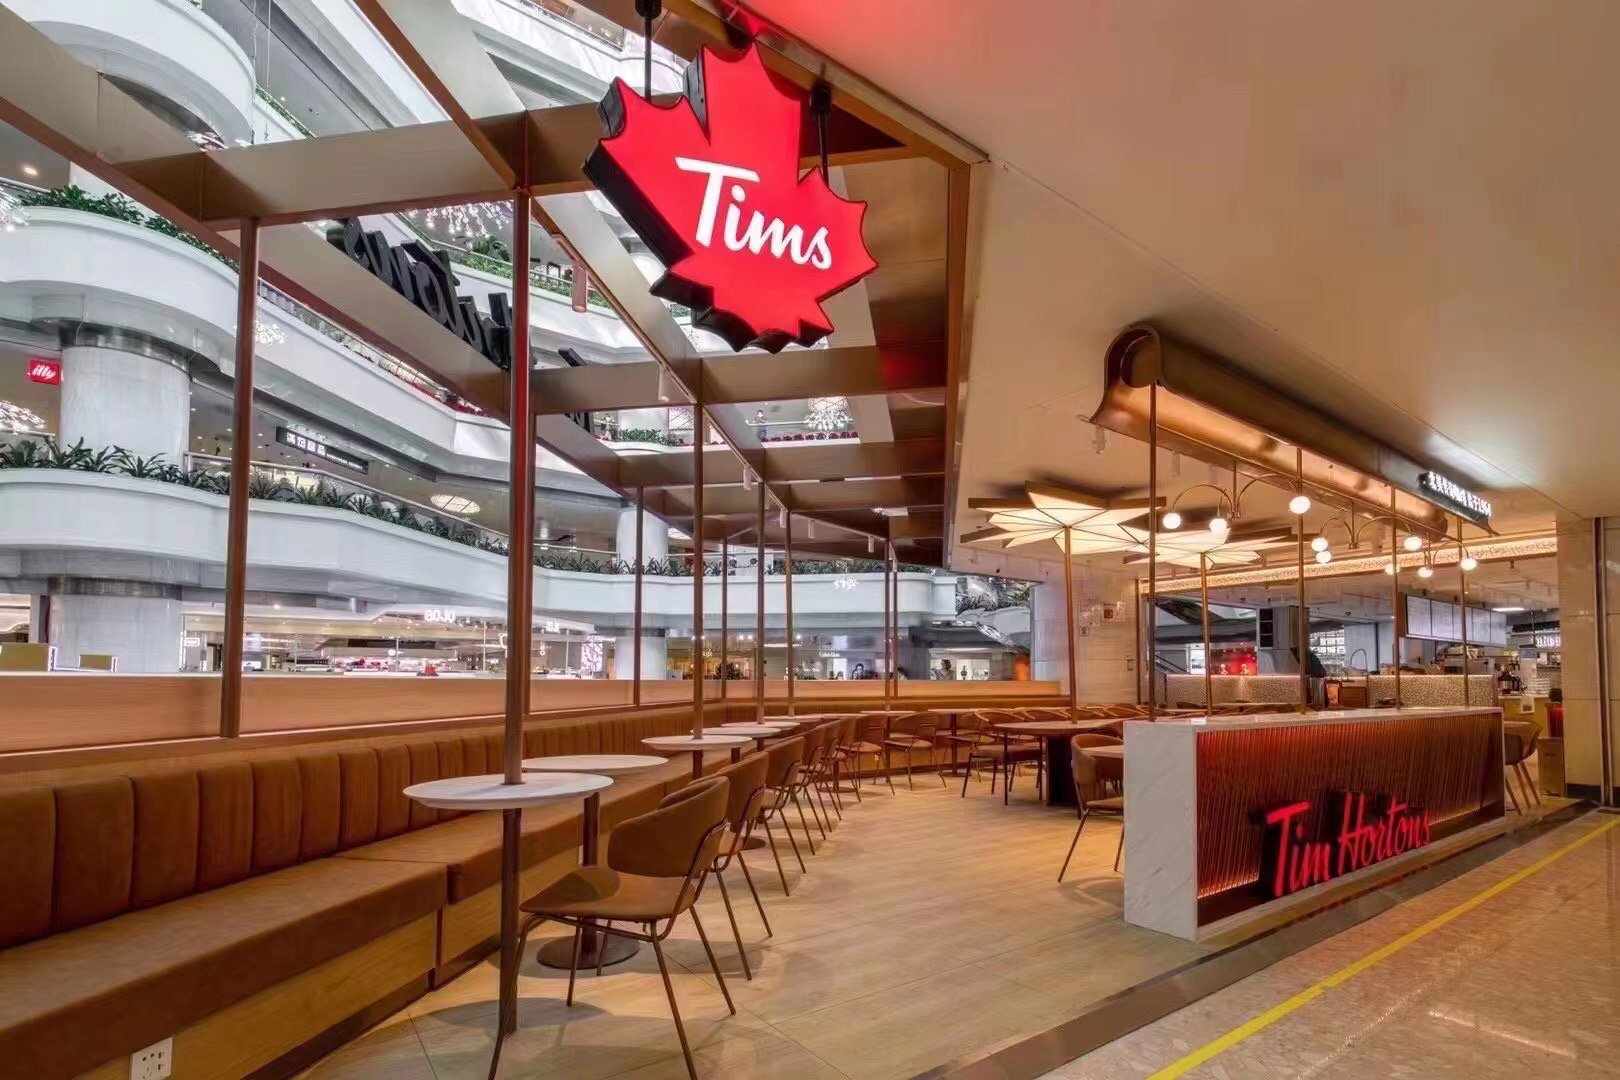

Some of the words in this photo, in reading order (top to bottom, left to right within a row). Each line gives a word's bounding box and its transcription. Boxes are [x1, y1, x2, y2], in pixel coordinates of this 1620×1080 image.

[675, 156, 832, 270] Tims
[31, 363, 57, 380] illy
[1266, 801, 1331, 897] Tim
[1338, 791, 1431, 875] Hortons
